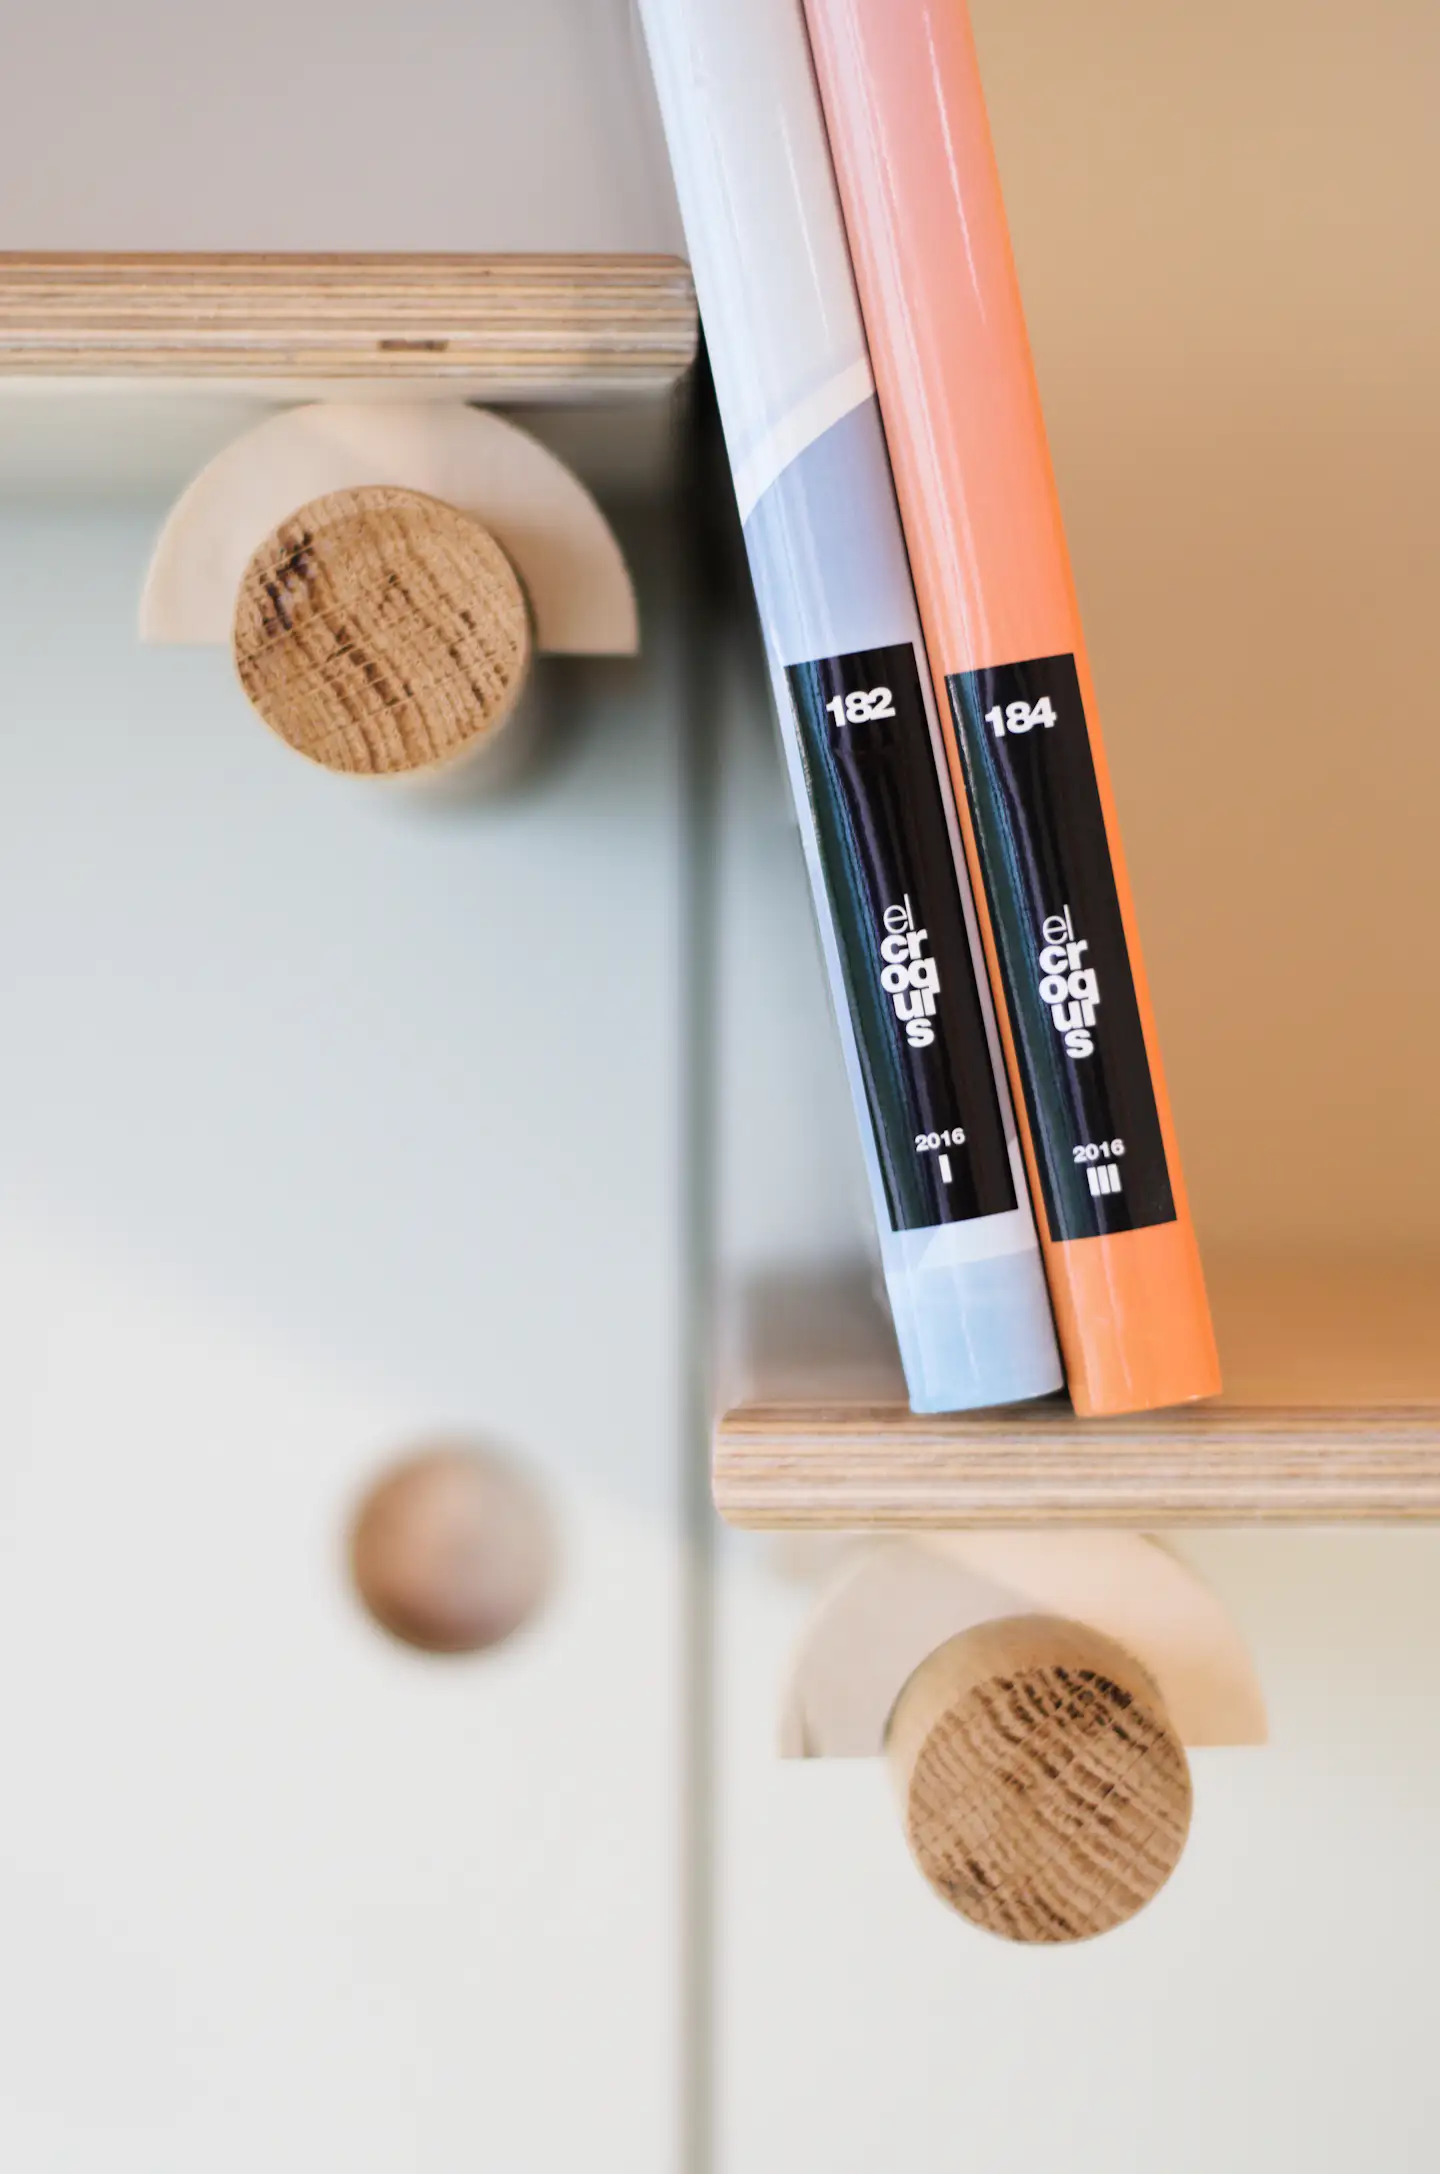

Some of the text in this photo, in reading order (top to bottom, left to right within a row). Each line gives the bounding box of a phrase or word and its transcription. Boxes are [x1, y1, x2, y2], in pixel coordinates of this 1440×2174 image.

[826, 687, 896, 727] 182
[985, 696, 1057, 737] 184
[915, 1127, 965, 1152] 2016
[1073, 1138, 1125, 1163] 2016
[1086, 1163, 1122, 1197] III
